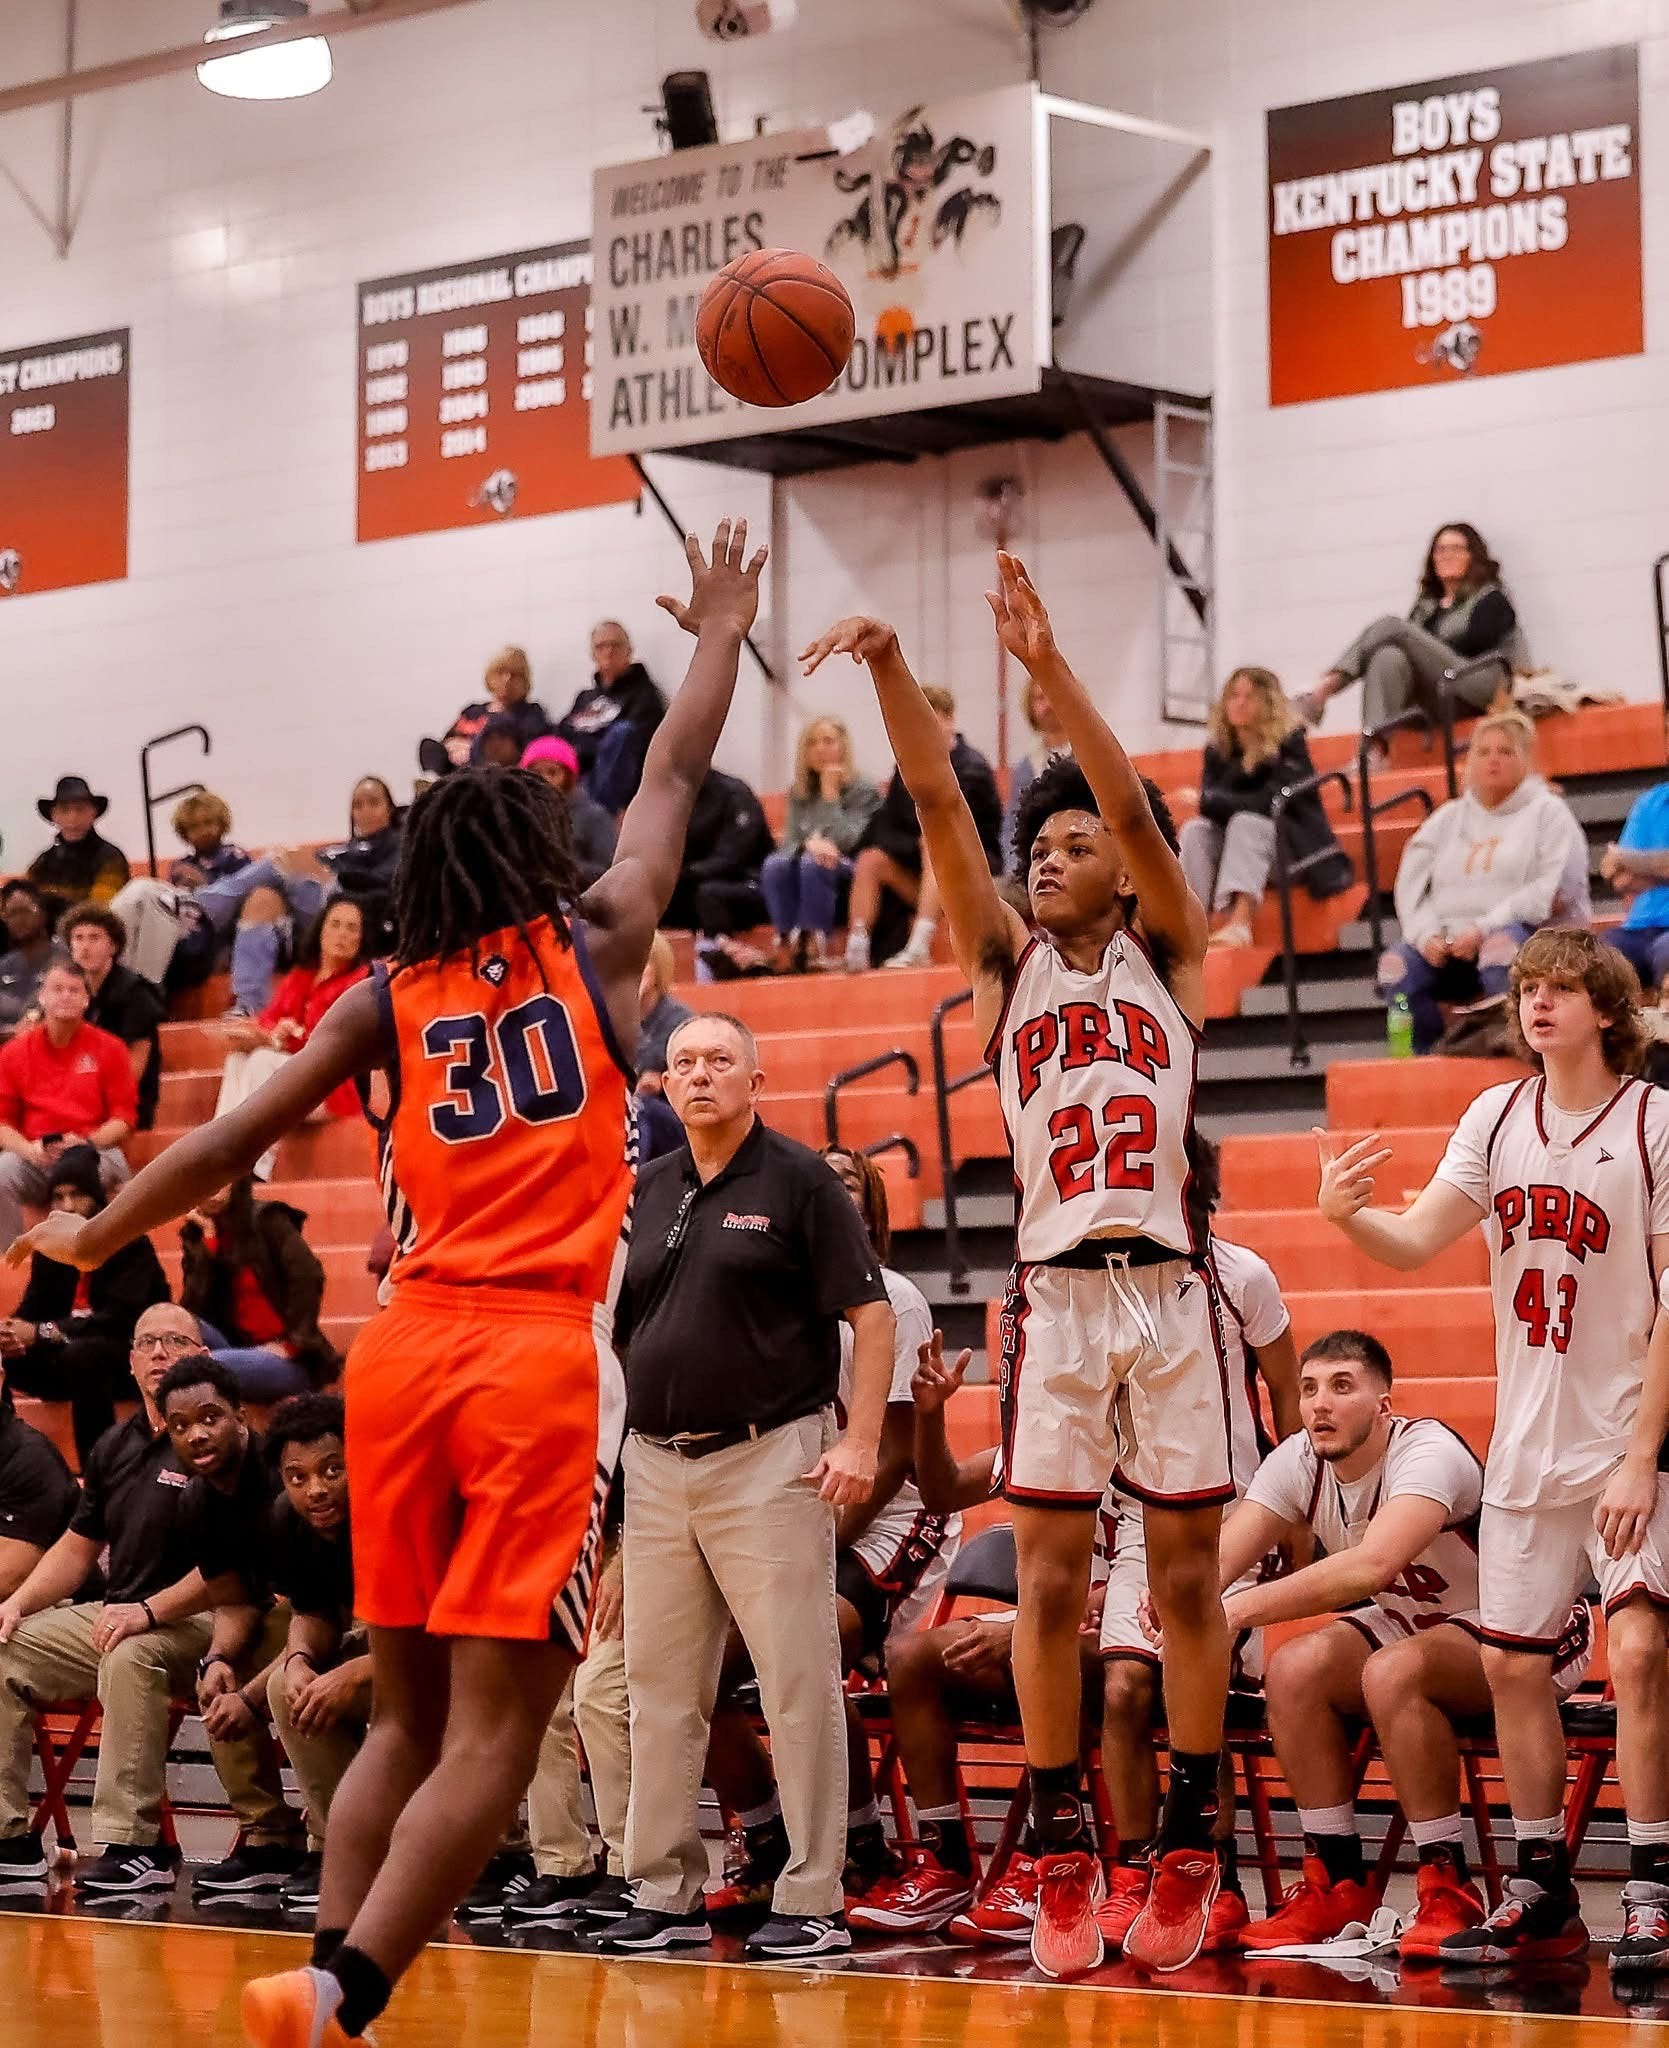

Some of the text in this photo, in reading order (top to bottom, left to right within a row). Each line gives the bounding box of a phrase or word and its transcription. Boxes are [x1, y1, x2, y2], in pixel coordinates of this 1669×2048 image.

[1392, 86, 1502, 156] BOYS
[610, 153, 787, 217] WELCOME TO THE
[1273, 124, 1633, 235] KENTUCKY STATE
[609, 212, 764, 288] CHARLES
[1331, 194, 1569, 284] CHAMPIONS
[363, 287, 415, 326] BOYS
[609, 304, 649, 356] W.
[1401, 263, 1497, 329] 1989
[608, 365, 744, 430] ATHLE
[828, 311, 1017, 397] OMPLEX
[421, 992, 589, 1145] 30
[1012, 998, 1172, 1112] PRP
[1047, 1094, 1158, 1205] 22
[1493, 1184, 1612, 1266] PRP
[1512, 1267, 1579, 1355] 43
